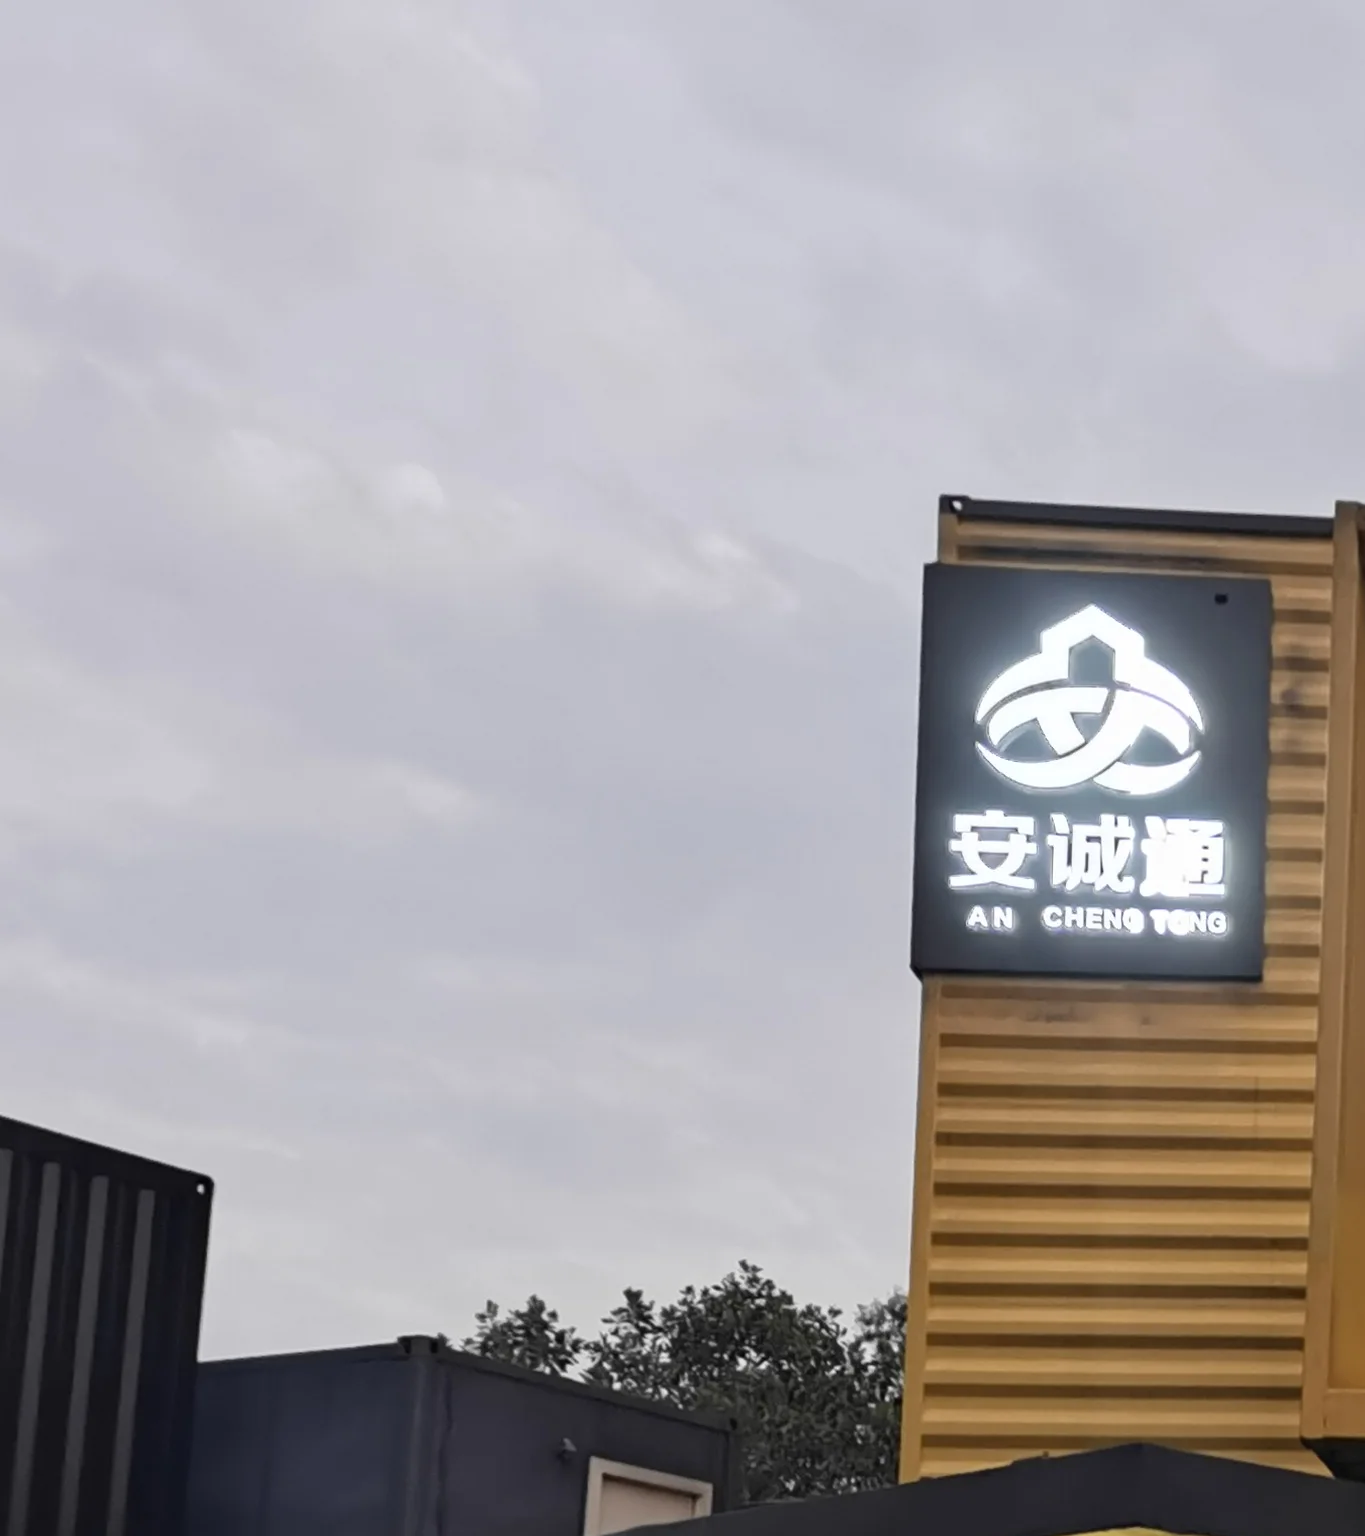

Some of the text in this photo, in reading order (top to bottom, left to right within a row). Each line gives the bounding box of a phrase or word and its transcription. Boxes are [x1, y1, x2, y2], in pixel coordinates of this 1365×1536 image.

[949, 810, 1227, 898] 安诚通
[967, 905, 1227, 936] AN CHENG TONG
